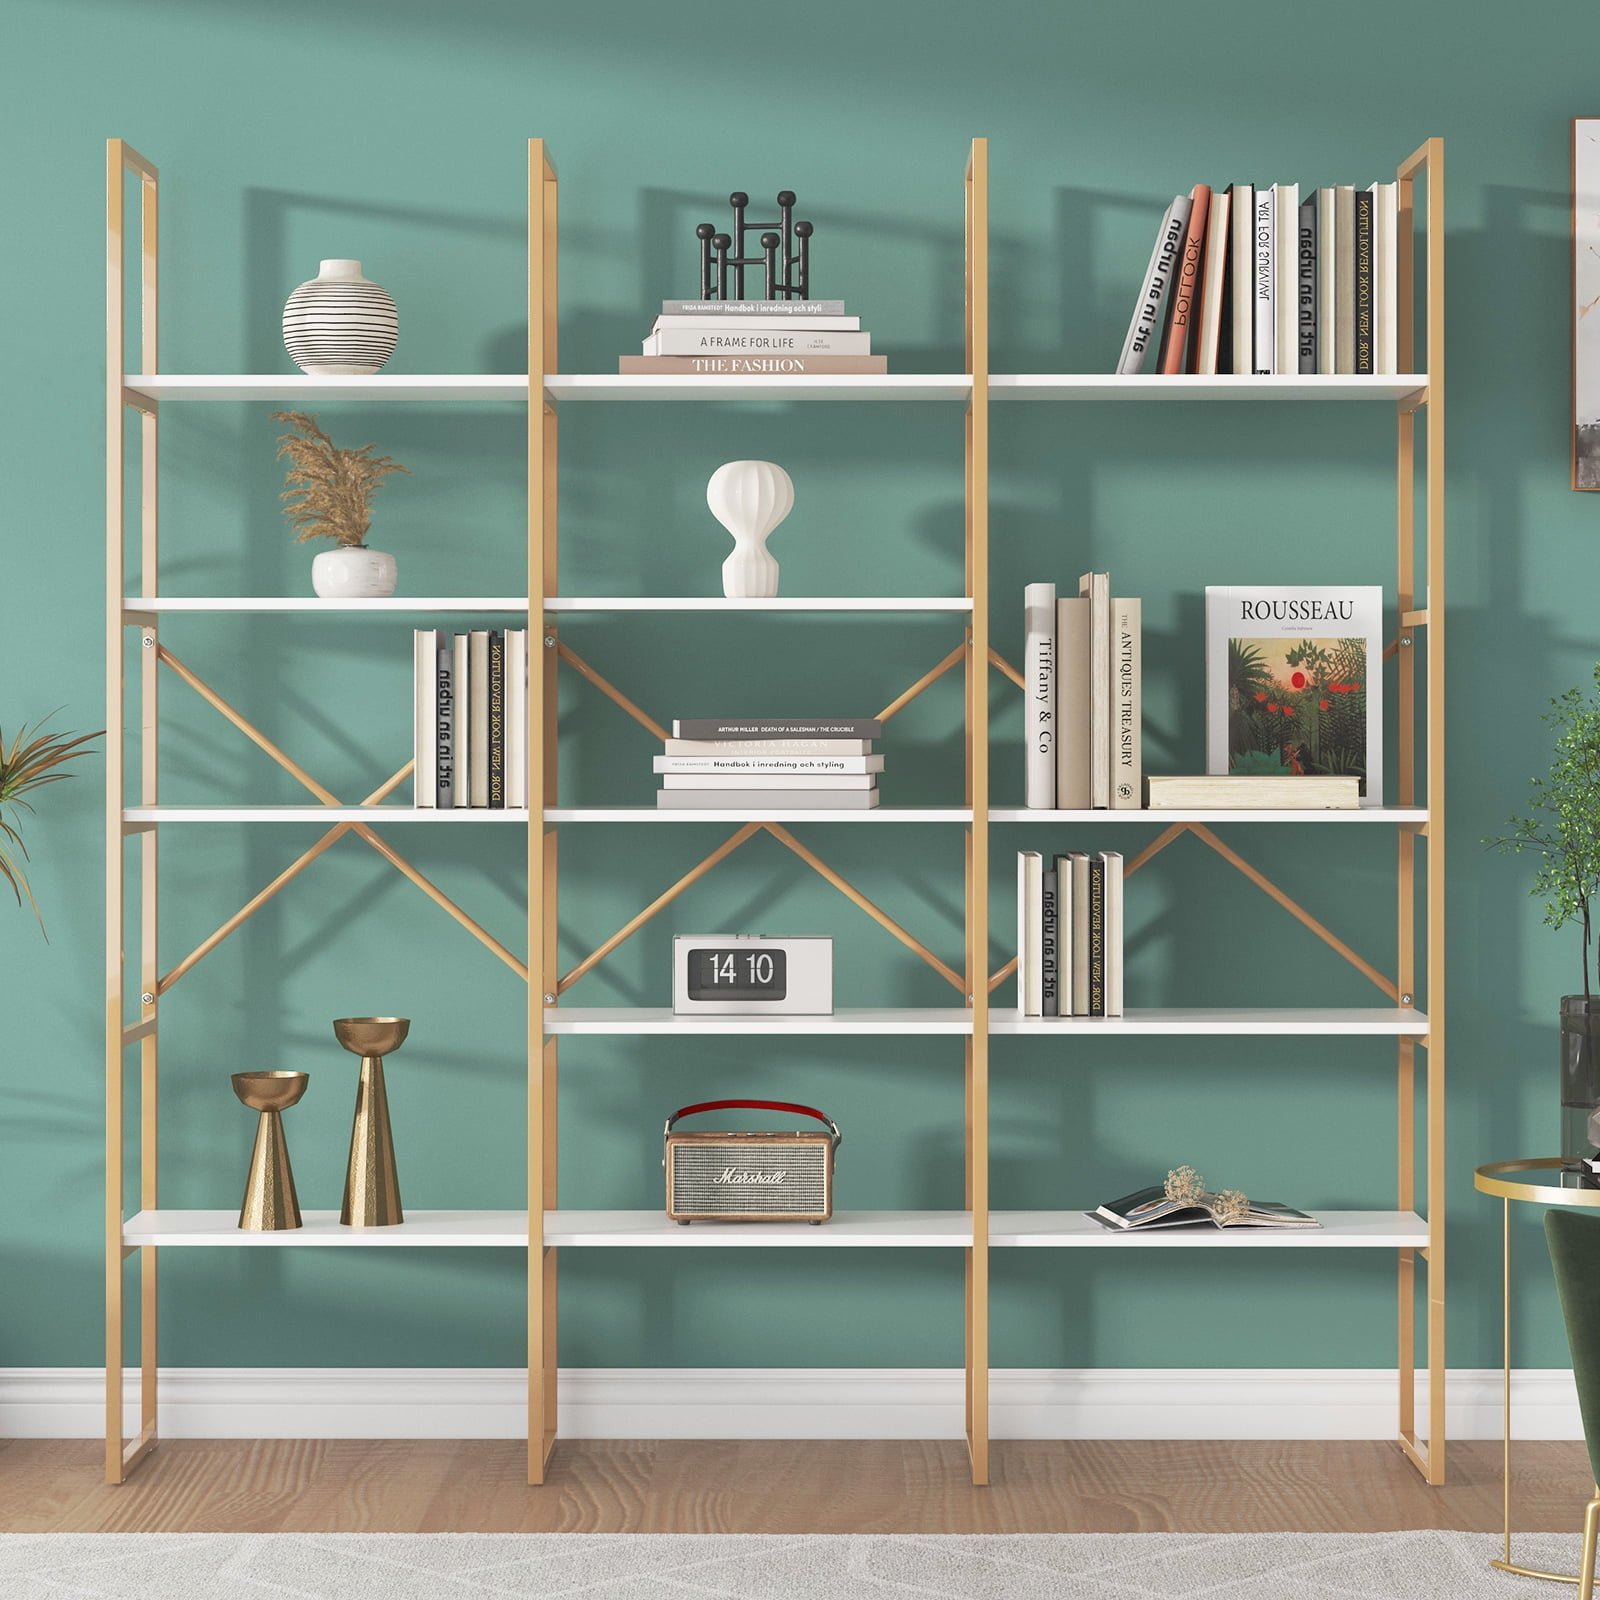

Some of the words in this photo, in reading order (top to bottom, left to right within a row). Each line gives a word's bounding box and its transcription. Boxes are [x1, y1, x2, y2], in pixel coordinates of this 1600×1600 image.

[724, 303, 755, 312] Handbok
[760, 303, 793, 314] inredning
[793, 303, 806, 312] och
[807, 303, 822, 314] styli
[700, 336, 708, 347] A
[710, 336, 747, 347] FRAME
[749, 337, 770, 348] FOR
[772, 338, 794, 348] LIFE
[692, 359, 728, 372] THE
[731, 359, 805, 372] FASHION
[1240, 600, 1354, 620] ROUSSEAU
[1036, 638, 1052, 704] Tiffany
[1119, 632, 1132, 697] ANTIQUES
[1039, 711, 1052, 723] &
[1039, 730, 1052, 754] Co
[1121, 701, 1132, 767] TREASURY
[714, 740, 776, 748] VICTORIA
[782, 740, 828, 748] HAGAN
[757, 761, 798, 769] inredning
[817, 761, 845, 769] styling
[709, 953, 737, 984] 14
[746, 953, 774, 984] 10
[713, 1167, 787, 1184] Marshall
